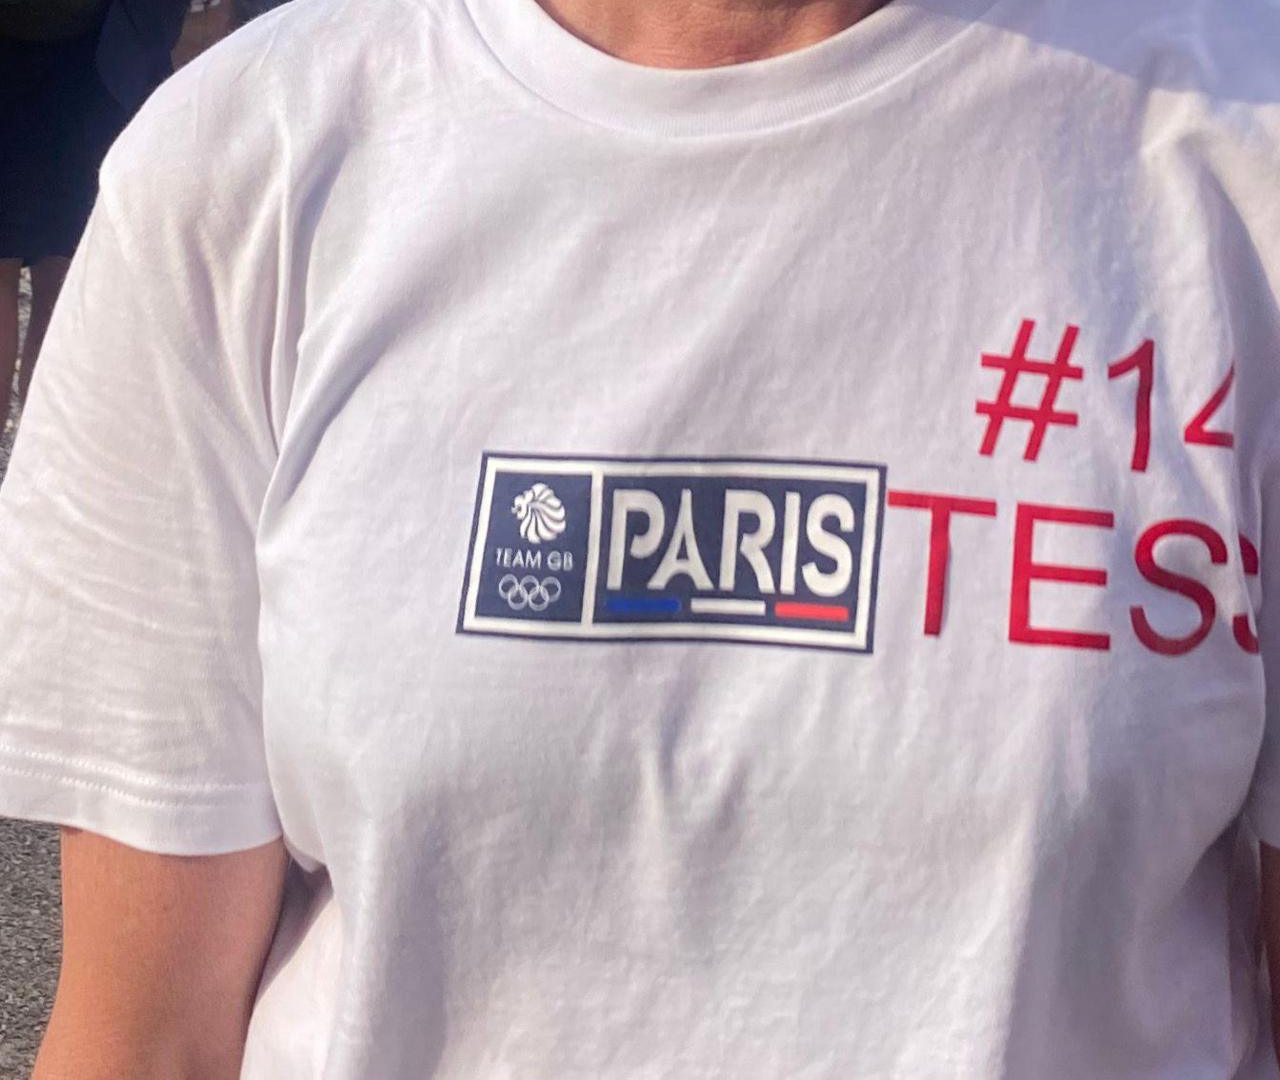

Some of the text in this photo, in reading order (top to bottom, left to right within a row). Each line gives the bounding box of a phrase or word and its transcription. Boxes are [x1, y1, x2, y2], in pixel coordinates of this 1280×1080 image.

[495, 548, 574, 571] TEAM GB
[607, 488, 854, 597] PARIS
